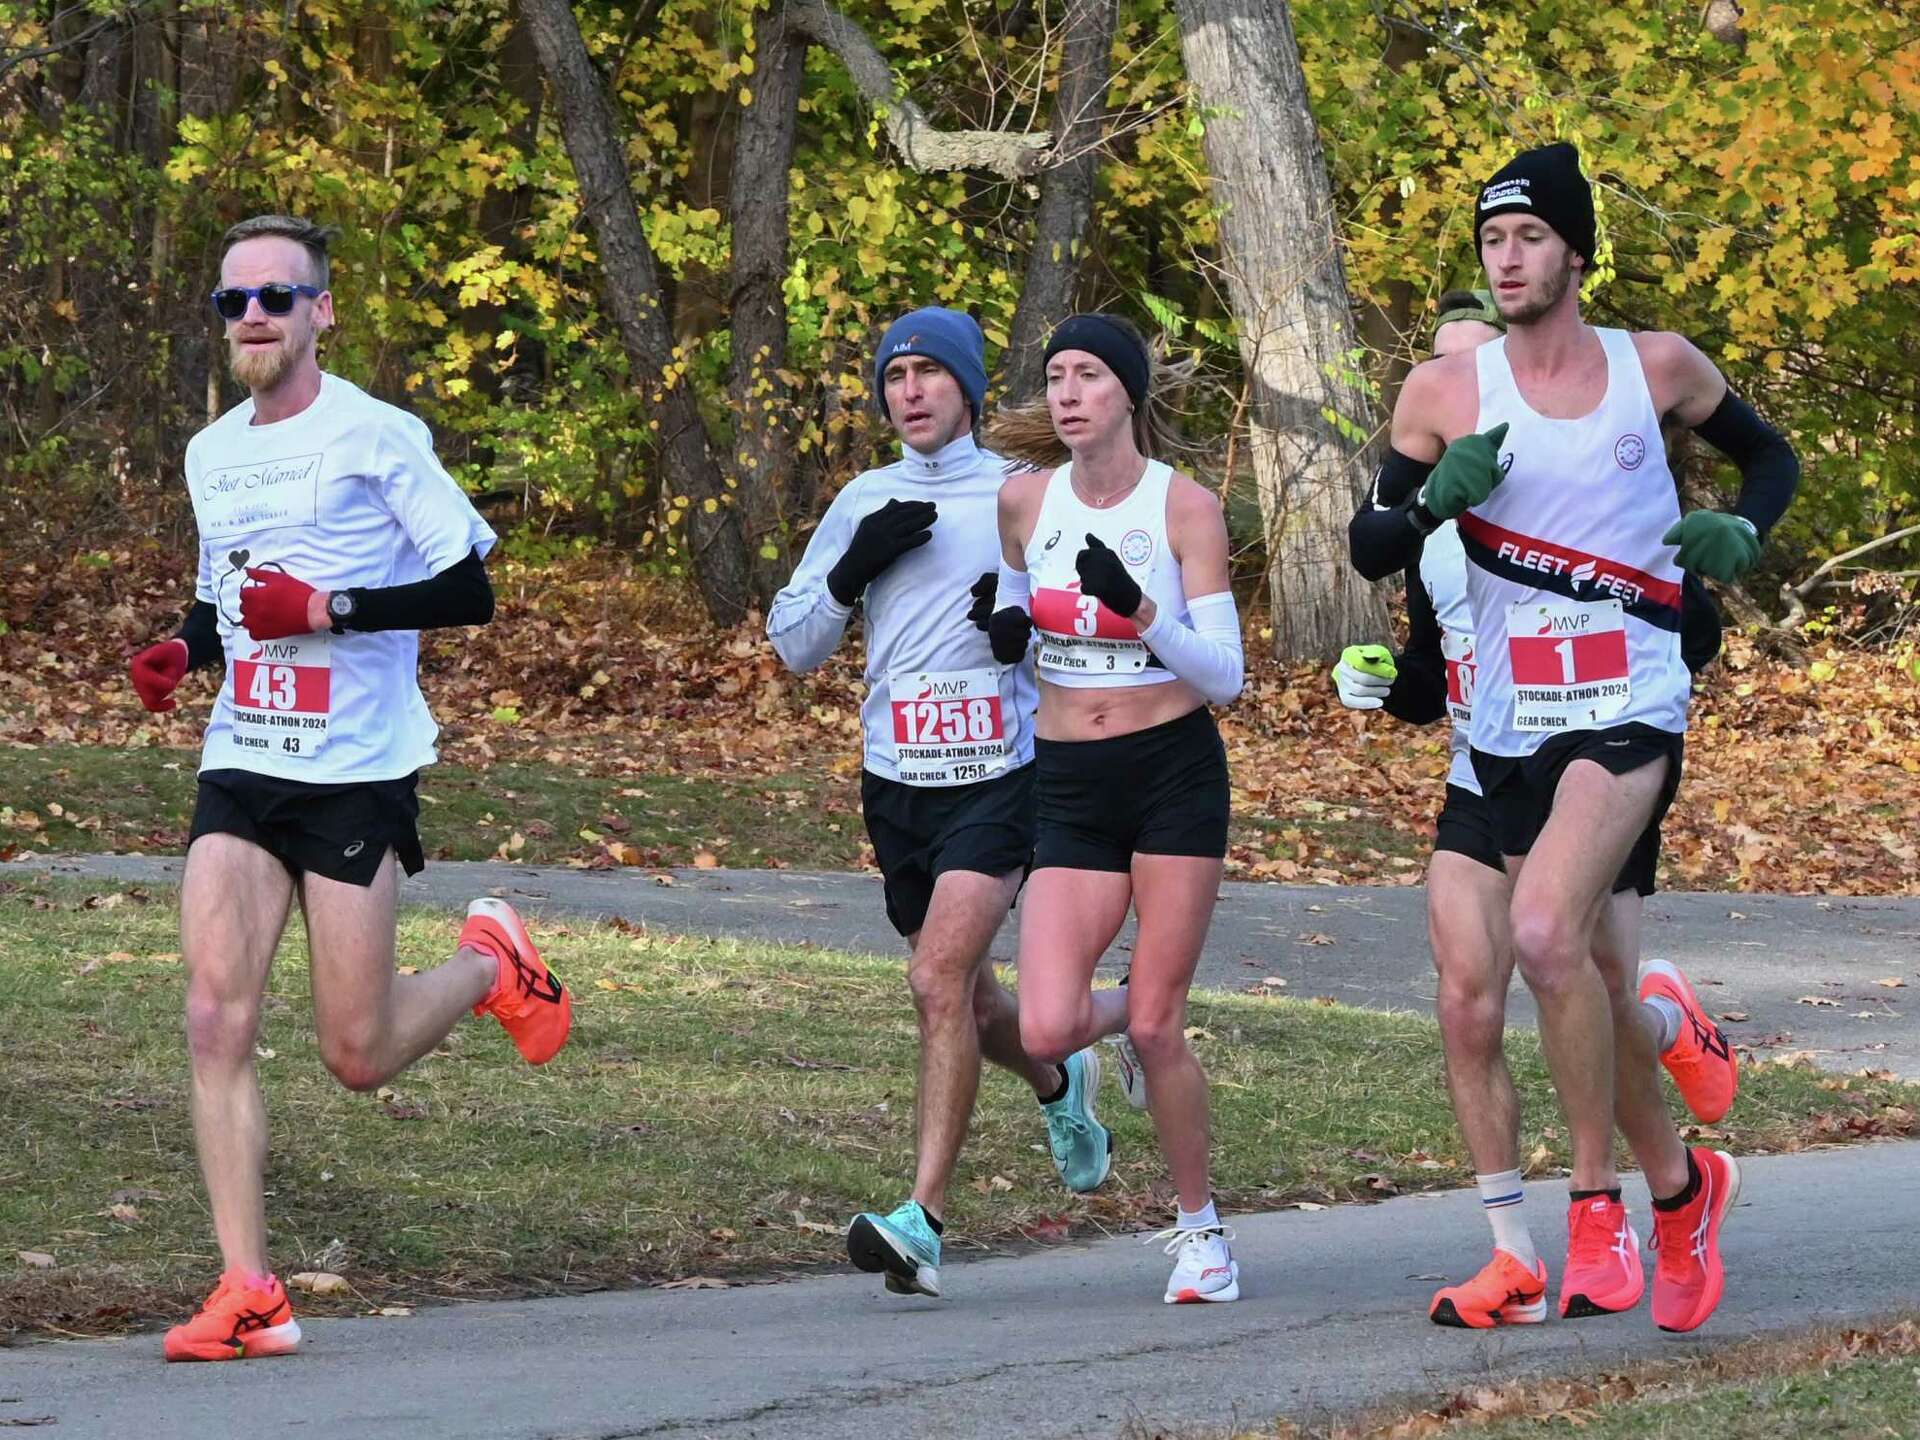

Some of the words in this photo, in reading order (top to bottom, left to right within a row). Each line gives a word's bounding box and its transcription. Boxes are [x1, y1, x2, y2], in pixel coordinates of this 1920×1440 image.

[203, 474, 240, 501] Just
[245, 461, 314, 489] Married
[1497, 541, 1569, 576] FLEET
[1594, 573, 1644, 603] FEET
[1074, 595, 1098, 637] 3
[1553, 614, 1590, 631] MVP
[264, 644, 299, 659] MVP
[1042, 653, 1063, 664] GEAR
[1063, 656, 1088, 668] CHECK
[1106, 655, 1116, 670] 3
[1554, 638, 1576, 684] 1
[249, 665, 297, 710] 43
[933, 680, 968, 695] MVP
[1518, 686, 1599, 702] STOCKADE-ATHON
[1602, 683, 1628, 697] 2024
[234, 710, 300, 728] TOCKADE-ATHON
[302, 718, 327, 729] 2024
[900, 699, 993, 743] 1258
[1517, 716, 1539, 726] GEAR
[1540, 716, 1568, 727] CHECK
[1589, 709, 1597, 721] 1
[244, 737, 269, 749] CHECK
[282, 737, 300, 753] 43
[899, 745, 976, 759] STOCKADE-ATHON
[978, 744, 1003, 757] 2024
[900, 771, 918, 781] GEAR
[920, 771, 947, 781] CHECK
[953, 763, 987, 780] 1258
